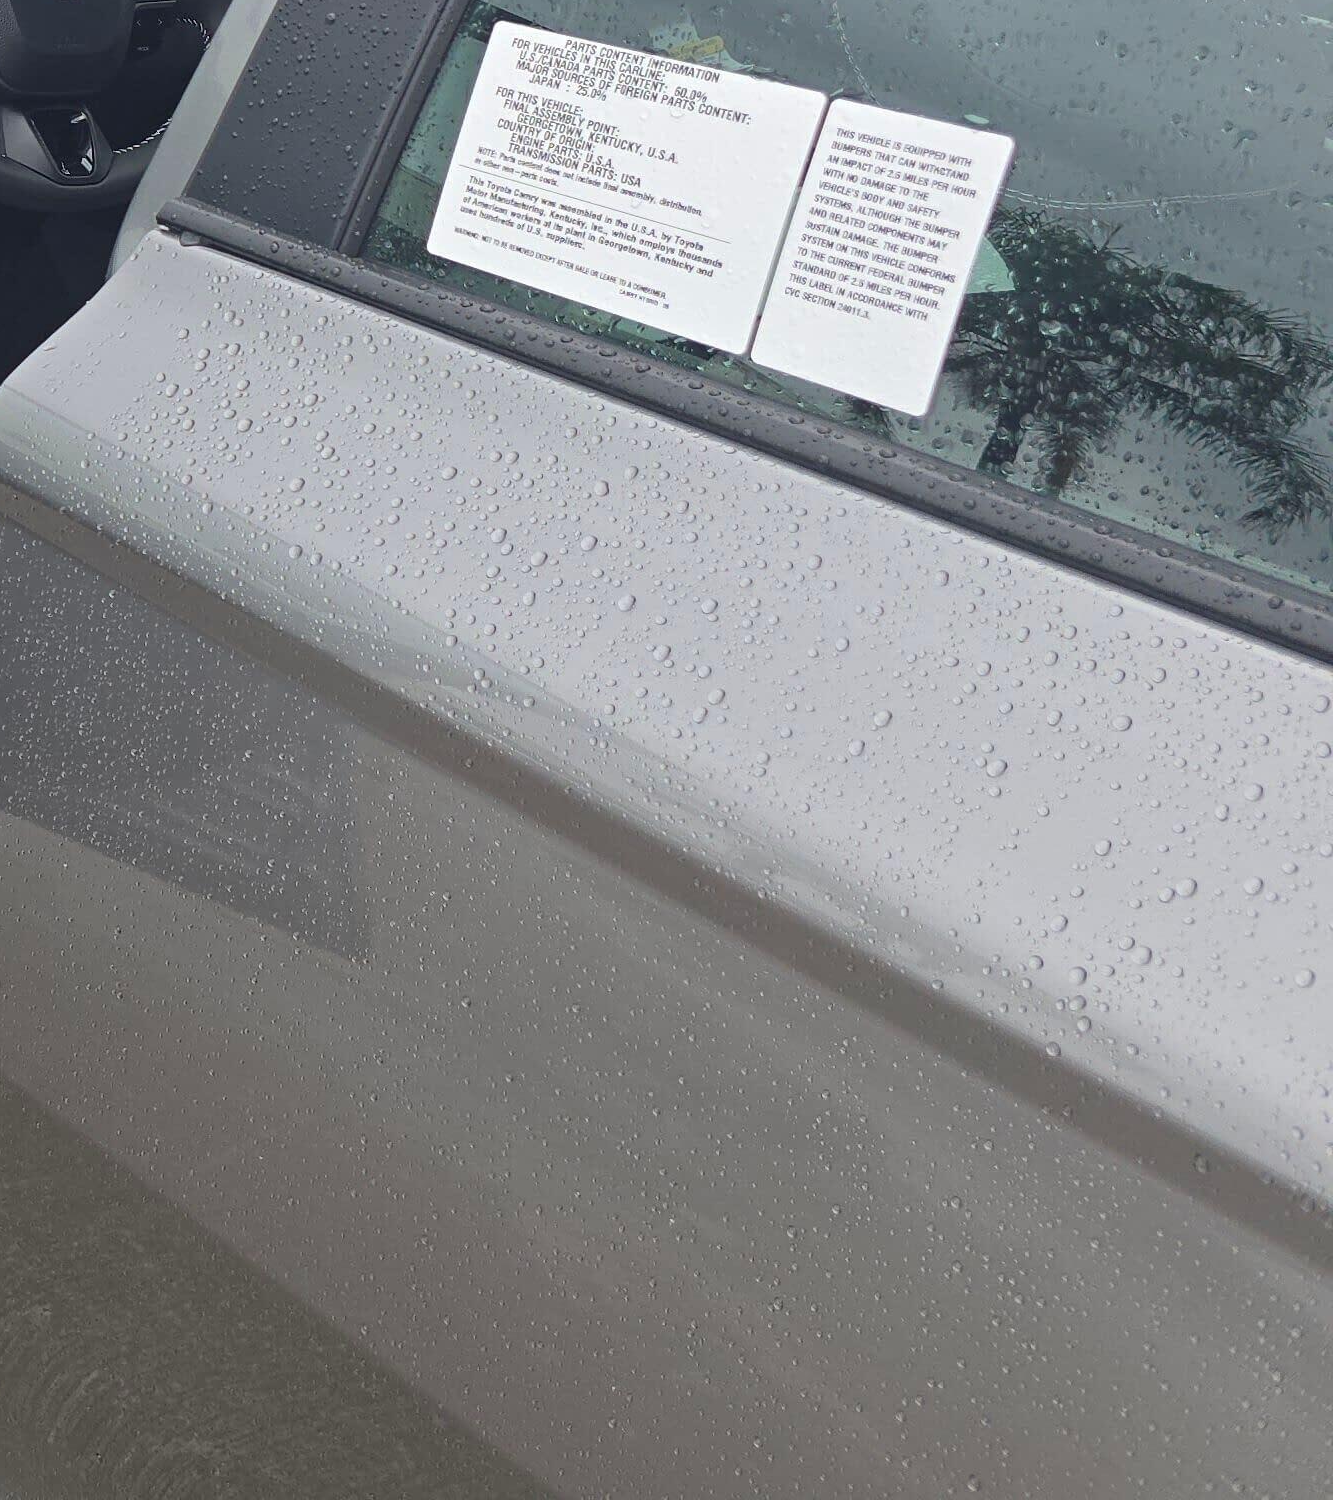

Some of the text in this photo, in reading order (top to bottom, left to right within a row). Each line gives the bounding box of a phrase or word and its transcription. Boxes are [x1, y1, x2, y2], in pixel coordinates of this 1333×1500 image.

[510, 37, 666, 81] FOR VEHICLES IN THIS CARLINE:
[518, 49, 581, 73] U.S./CANADA
[582, 64, 616, 81] PARTS
[617, 72, 669, 93] CONTENT:
[564, 39, 721, 83] PARTS CONTENT INFORMATION
[495, 85, 584, 116] FOR THIS VEHICLE:
[514, 59, 752, 125] MAJOR SOURCES OF FOREIGN PARTS CONTENT:
[528, 73, 561, 90] JAPAN
[575, 85, 608, 101] 25.0%
[496, 118, 596, 152] COUNTRY OF ORIGIN:
[502, 98, 620, 136] FINAL ASSEMBLY POINT:
[509, 132, 616, 169] ENGINE PARTS: U.S.A.
[515, 112, 681, 164] GEORGETOWN, KENTUCKY, U.S.A.
[830, 140, 873, 158] BUMPERS
[873, 151, 897, 164] THAT
[896, 156, 917, 168] CAN
[834, 127, 973, 167] THIS VEHICLE IS EQUIPPED WITH
[506, 142, 643, 187] TRANSMISSION PARTS: USA
[821, 167, 930, 201] WITH NO DAMAGE TO THE
[825, 154, 840, 165] AN
[839, 157, 873, 173] IMPACT
[872, 165, 886, 176] OF
[901, 172, 930, 187] MILES
[930, 178, 950, 191] PER
[950, 183, 977, 198] HOUR
[855, 204, 902, 224] ALTHOUGH
[902, 216, 921, 229] THE
[921, 221, 961, 239] BUMPER
[860, 191, 885, 204] BODY
[885, 197, 906, 210] AND
[905, 202, 941, 218] SAFETY
[804, 220, 841, 237] SUSTAIN
[882, 240, 900, 253] THE
[900, 245, 939, 263] BUMPER
[807, 206, 948, 250] AND RELATED COMPONENTS MAY
[795, 246, 946, 295] TO THE CURRENT FEDERAL BUMPER
[799, 233, 835, 250] SYSTEM
[834, 242, 849, 254] ON
[848, 246, 870, 260] THIS
[869, 251, 906, 269] VEHICLE
[783, 286, 801, 298] CVC
[800, 291, 837, 309] SECTION
[787, 272, 929, 321] THIS LABEL IN ACCORDANCE WITH
[791, 259, 837, 280] STANDARD
[836, 272, 850, 284] OF
[865, 280, 893, 296] MILES
[892, 288, 912, 301] PER
